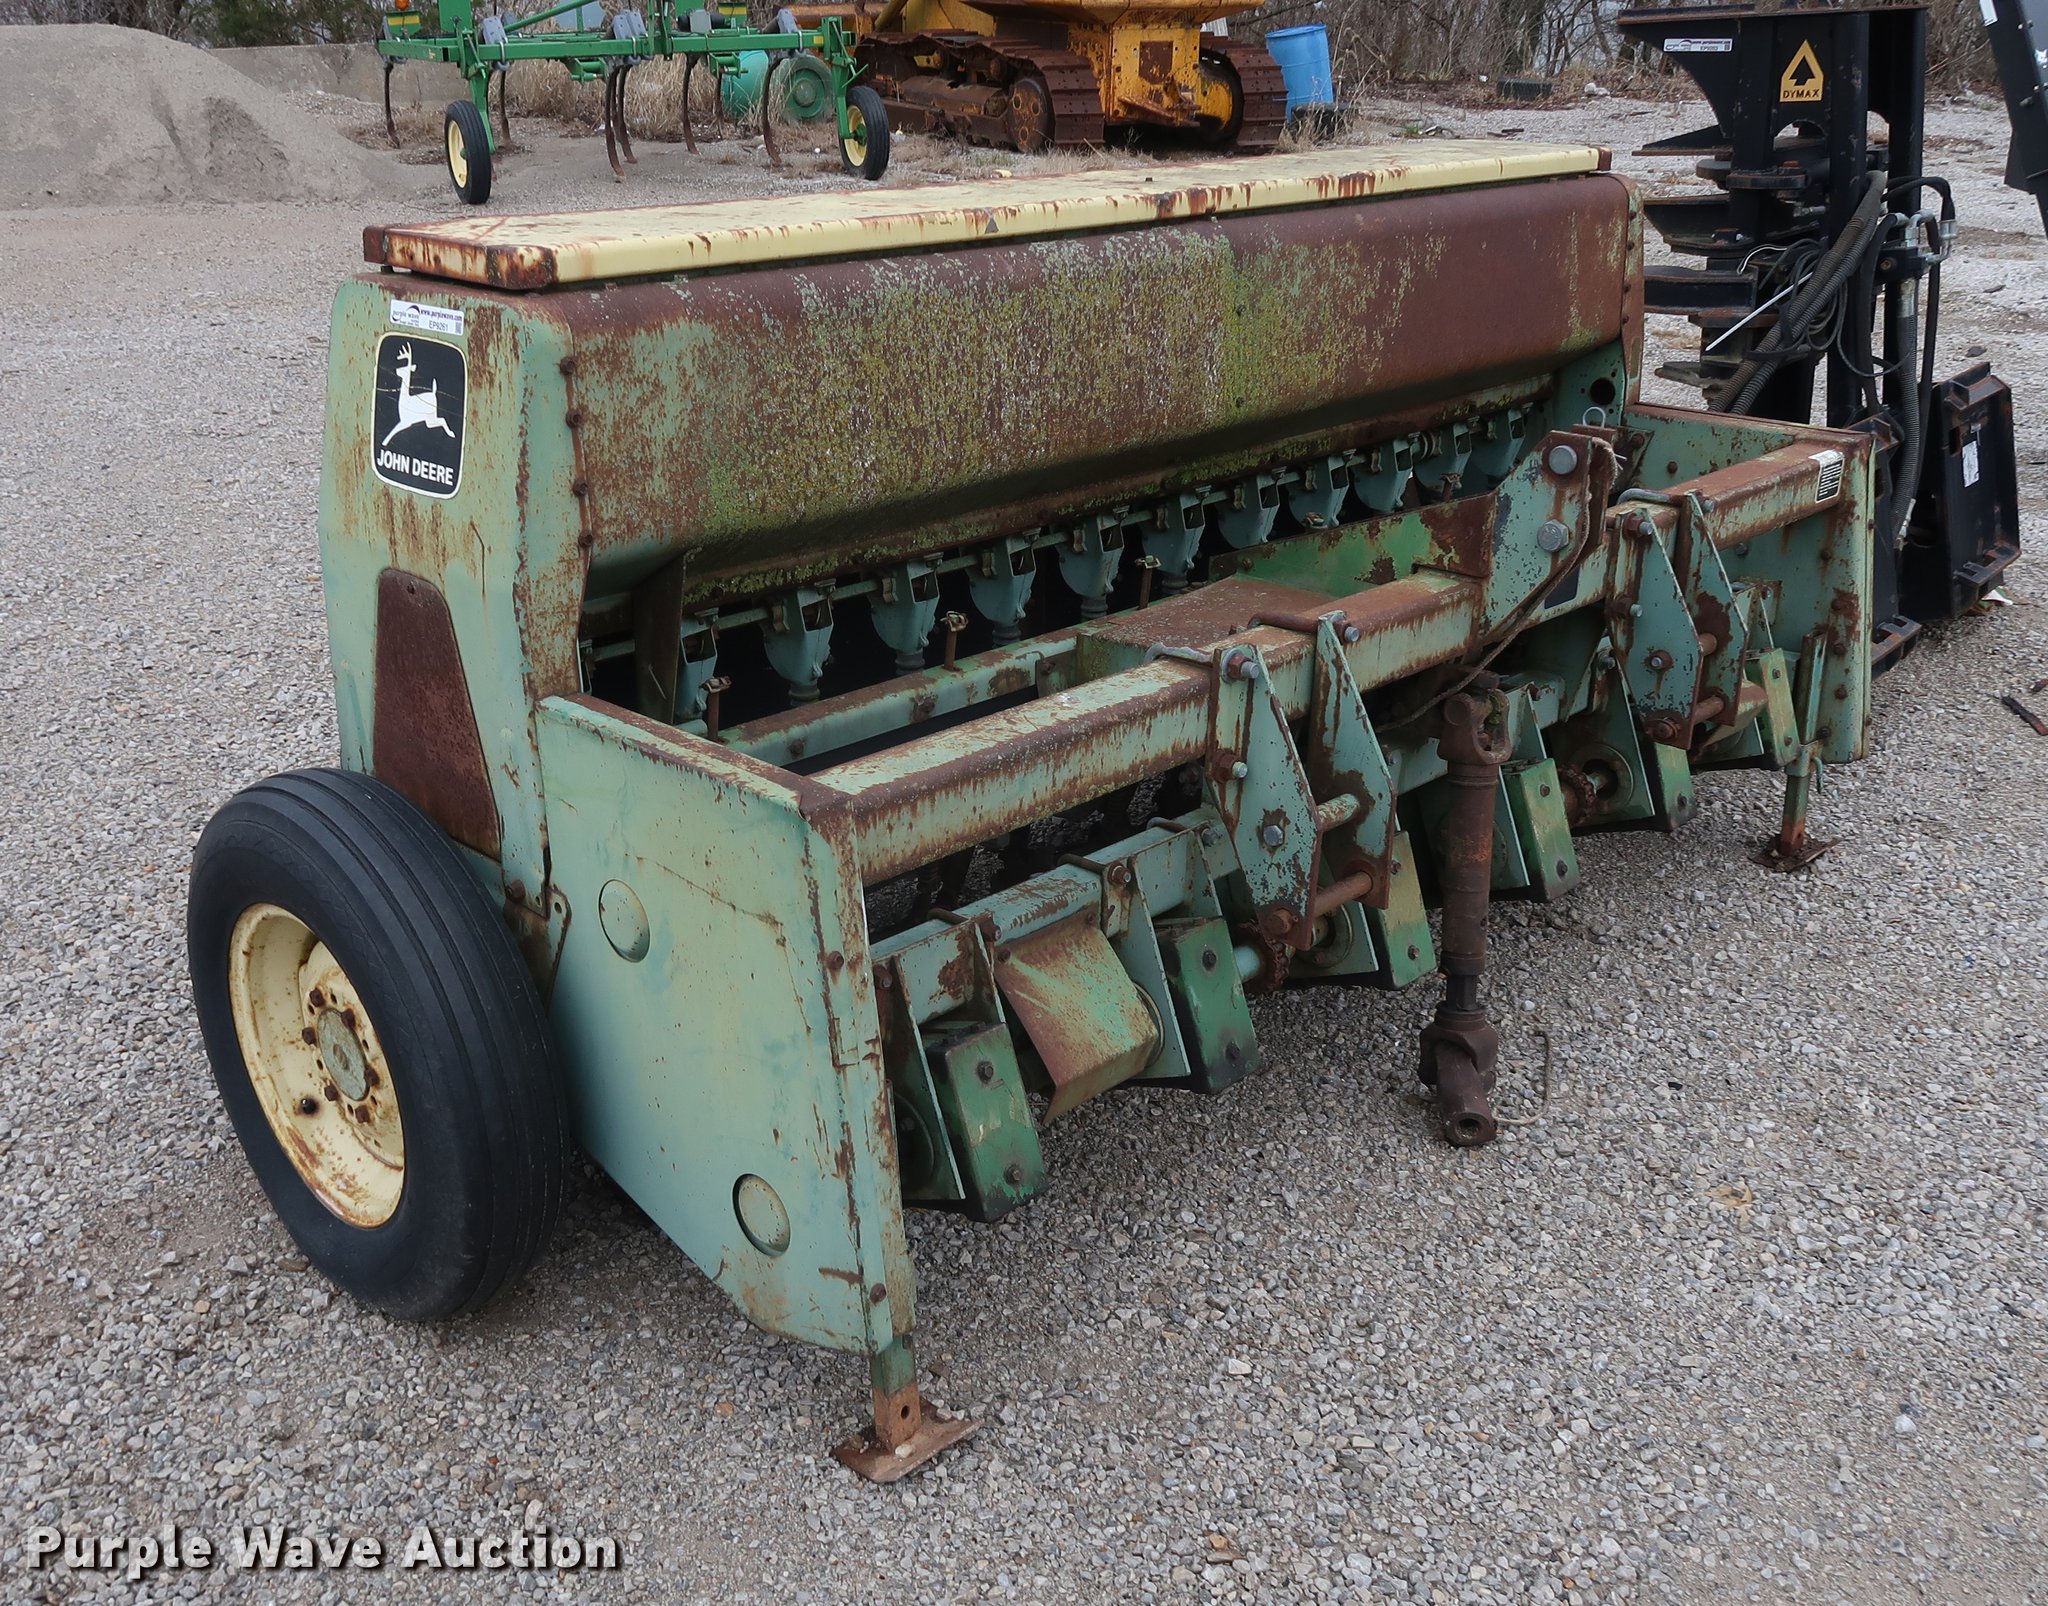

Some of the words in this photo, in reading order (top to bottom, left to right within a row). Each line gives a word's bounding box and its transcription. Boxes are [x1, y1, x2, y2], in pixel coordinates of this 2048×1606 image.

[1783, 89, 1820, 98] DYMAX
[377, 449, 410, 474] JOHN
[412, 458, 454, 486] DEERE
